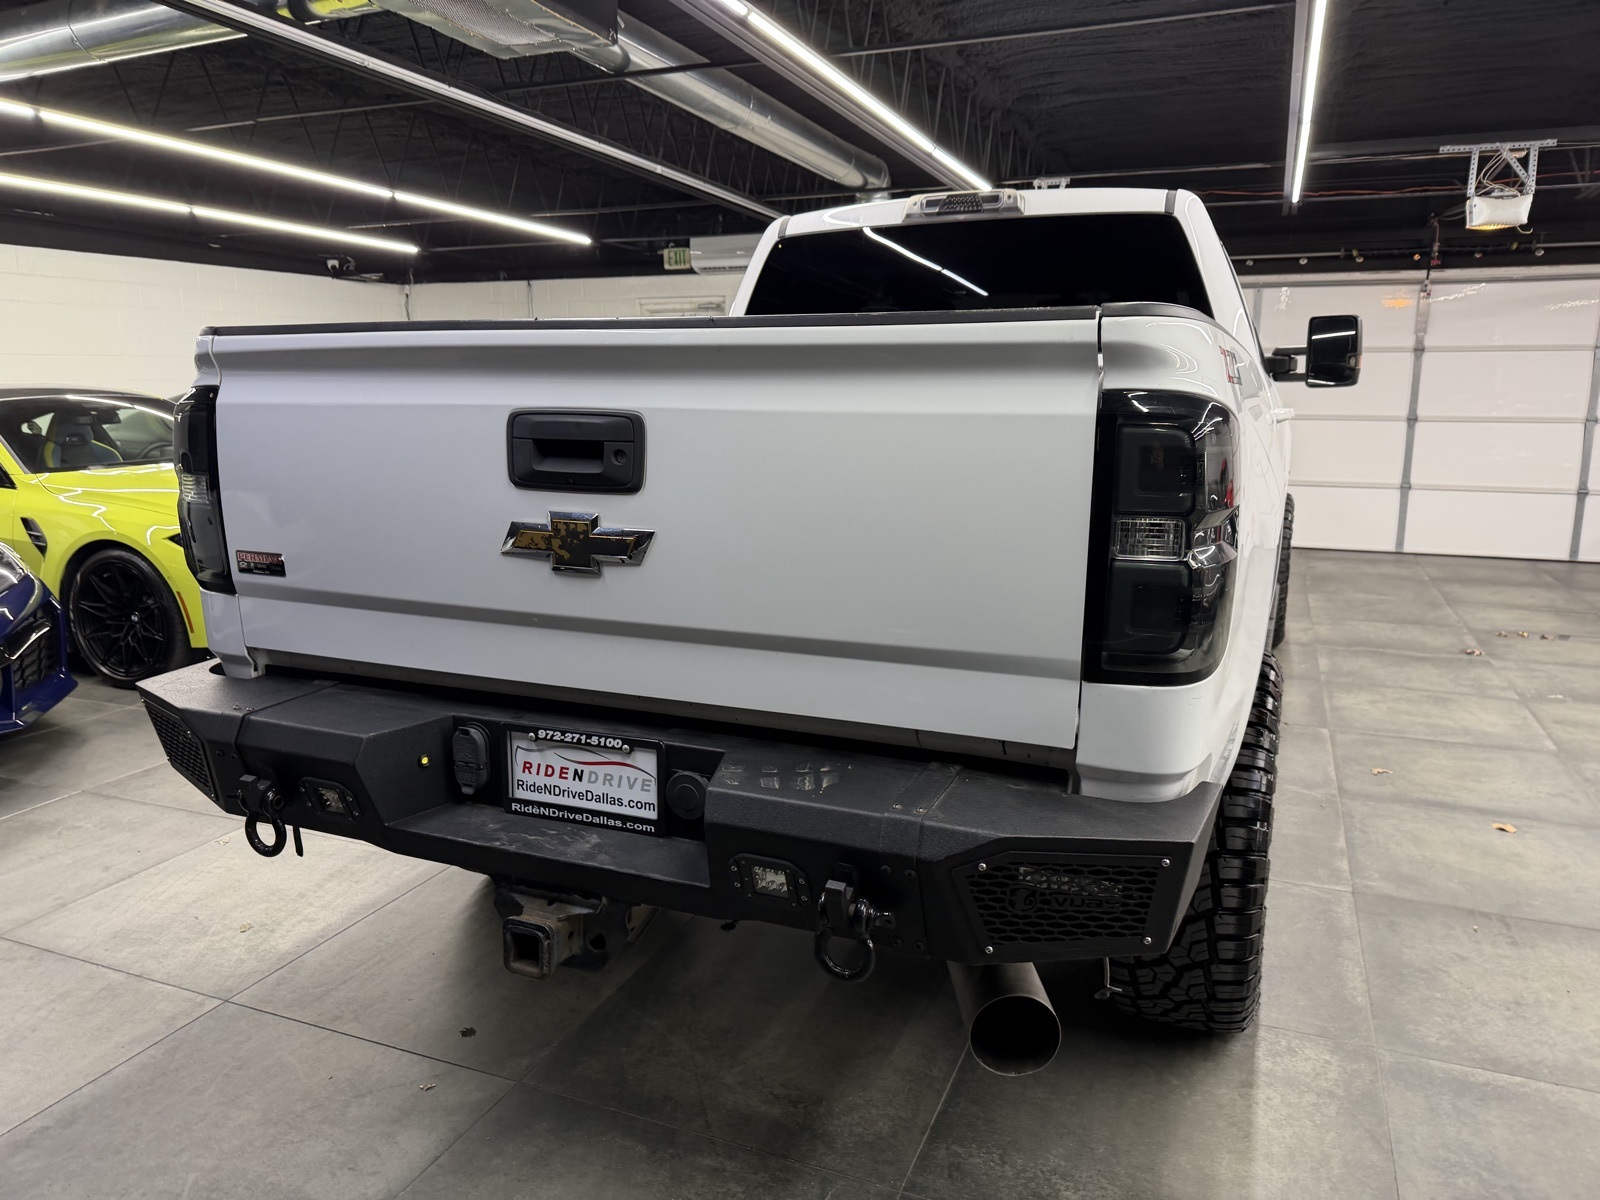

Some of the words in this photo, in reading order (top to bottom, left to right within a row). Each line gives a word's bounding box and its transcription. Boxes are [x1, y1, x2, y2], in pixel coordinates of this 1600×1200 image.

[667, 249, 687, 267] EXIT
[537, 729, 623, 749] 972-271-5100
[521, 760, 653, 793] RIDENDRIVE
[516, 778, 656, 812] RideNDriveDallas.com
[511, 802, 655, 833] RideNDriveDallas.com
